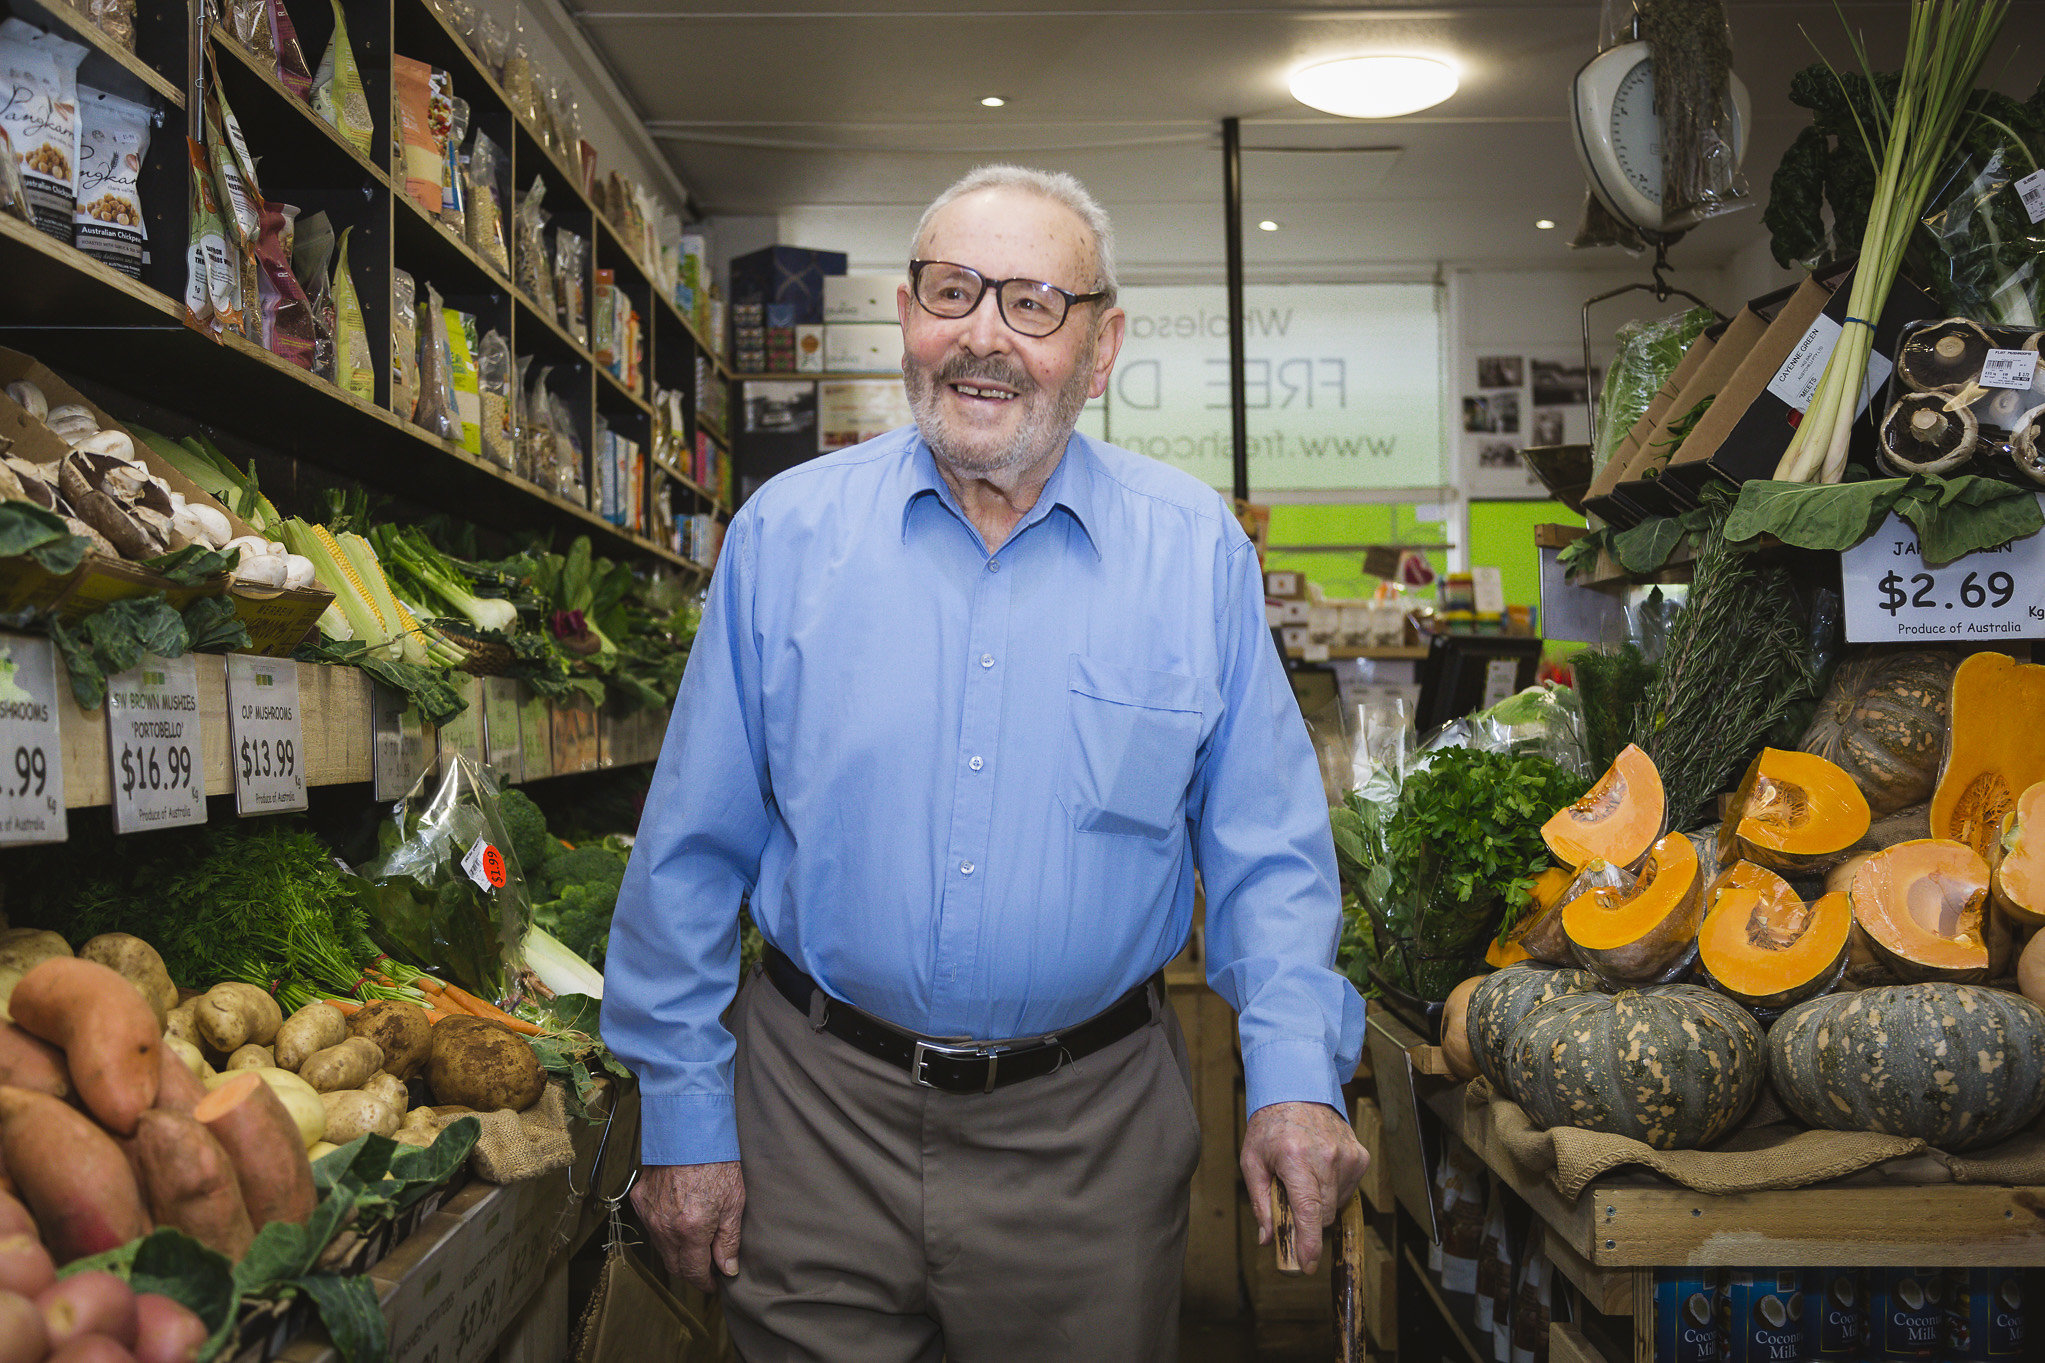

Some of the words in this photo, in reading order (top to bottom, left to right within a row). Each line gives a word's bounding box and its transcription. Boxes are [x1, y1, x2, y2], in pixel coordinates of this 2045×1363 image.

[81, 226, 117, 237] Australian
[1779, 350, 1804, 383] CAYENNE
[1800, 328, 1819, 352] GREEN
[1878, 570, 2015, 617] $2.69
[2028, 605, 2045, 620] Kg
[1898, 623, 1946, 634] Produce
[1949, 622, 1962, 633] of
[1967, 621, 2021, 633] Australia
[129, 692, 160, 710] BROWN
[162, 694, 196, 711] MUSHIES
[255, 705, 293, 721] MUSHROOMS
[131, 721, 184, 738] 'PORTOBELLO'
[241, 735, 295, 786] $13.99
[0, 746, 46, 797] .99
[121, 742, 192, 801] $16.99
[294, 774, 302, 790] Kg
[191, 786, 200, 803] Kg
[255, 791, 272, 804] Produce
[278, 790, 296, 803] Australia
[46, 795, 57, 815] Kg
[139, 807, 161, 821] Produce
[168, 805, 191, 819] Australia
[487, 850, 504, 883] $1.99
[1908, 1327, 1937, 1341] Milk
[1769, 1344, 1798, 1359] Milk
